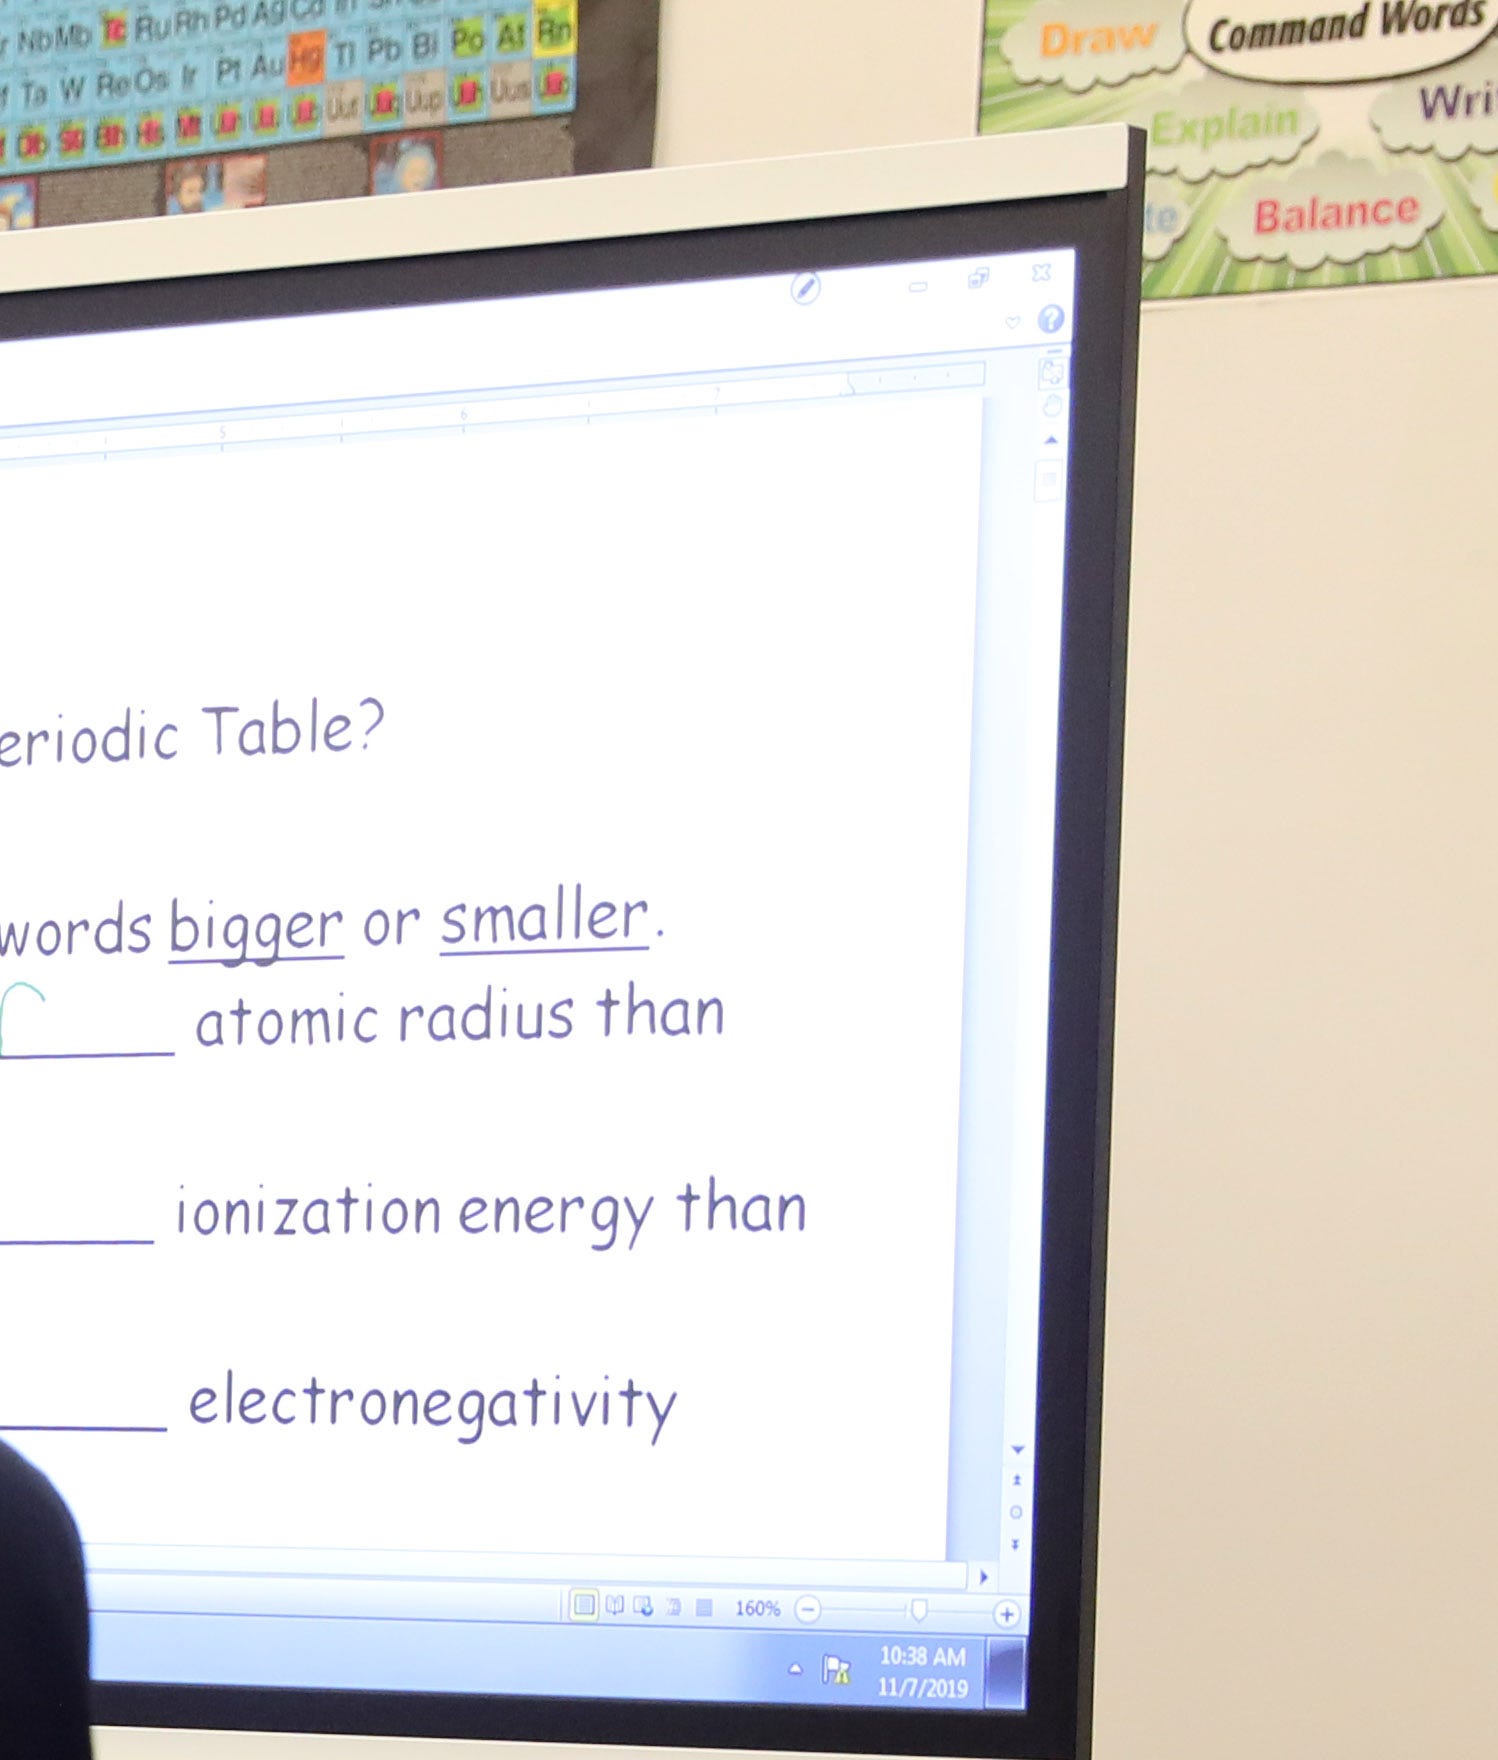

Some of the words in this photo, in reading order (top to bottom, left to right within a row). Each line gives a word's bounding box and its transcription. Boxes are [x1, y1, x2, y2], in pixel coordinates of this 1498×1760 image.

[1040, 21, 1157, 59] Draw
[1210, 2, 1369, 52] Command
[1382, 0, 1487, 36] Words
[60, 75, 85, 100] W
[1420, 81, 1498, 121] Wri
[1152, 104, 1299, 148] Explain
[1255, 195, 1419, 235] Balance
[201, 697, 385, 756] Table?
[168, 897, 345, 968] bigger
[364, 907, 420, 947] or
[440, 882, 664, 957] smaller.
[196, 991, 379, 1047] atomic
[399, 985, 574, 1042] radius
[595, 980, 724, 1037] than
[177, 1183, 442, 1236] ionization
[458, 1194, 655, 1253] energy
[675, 1175, 806, 1232] than
[189, 1368, 678, 1447] electronegativity
[736, 1599, 781, 1618] 160%
[880, 1645, 929, 1667] 10:38
[933, 1647, 967, 1668] AM
[878, 1677, 969, 1699] 11/7/2019
